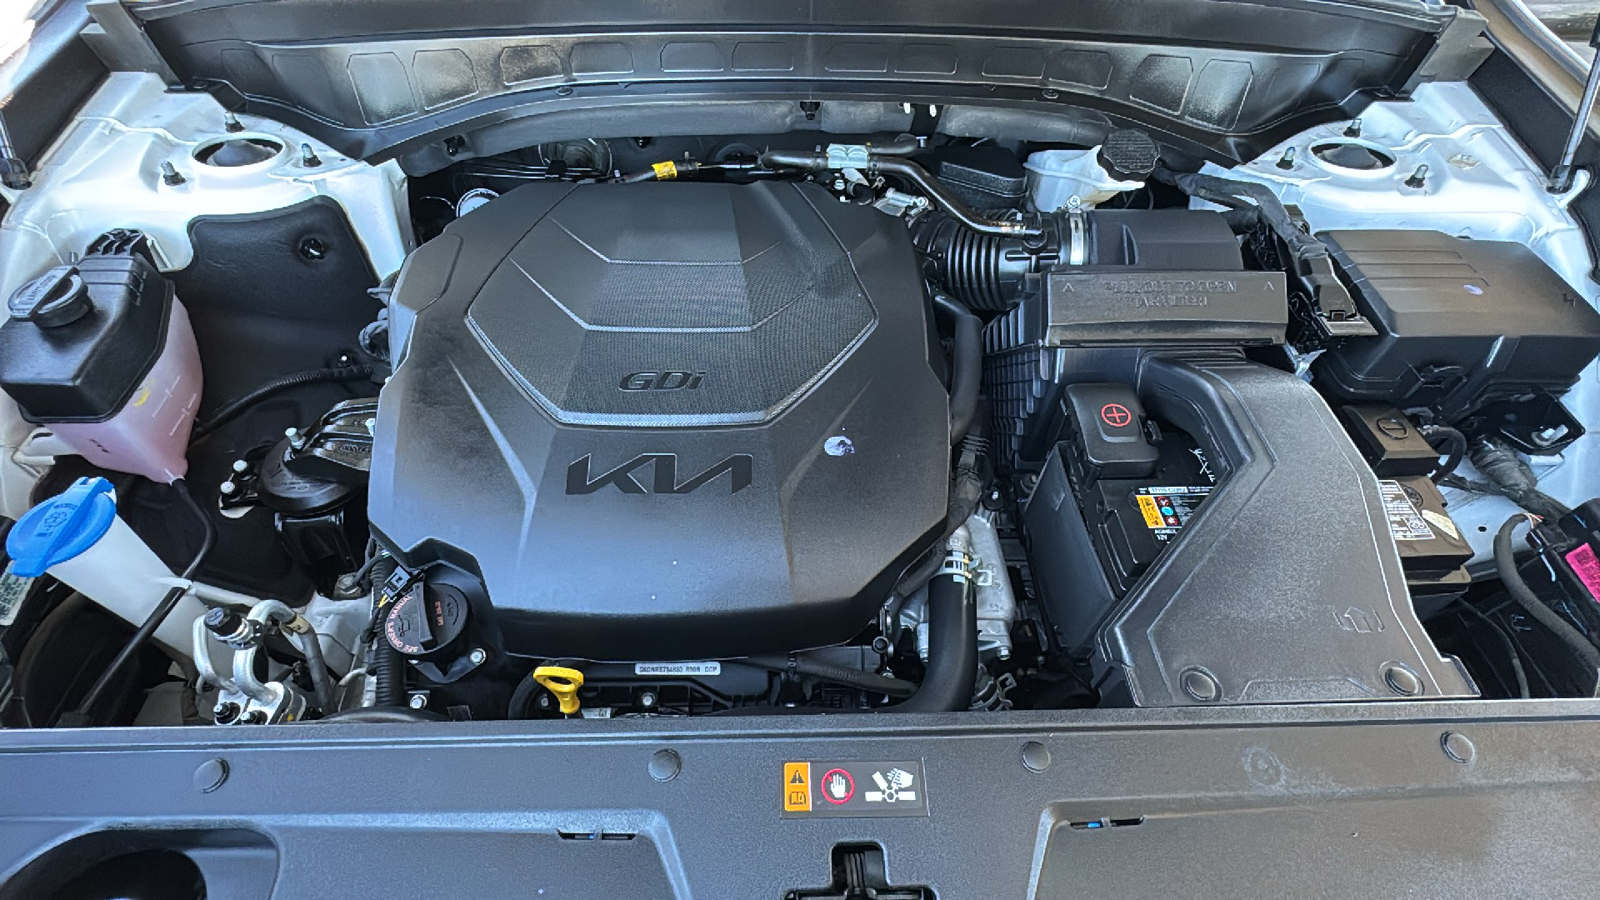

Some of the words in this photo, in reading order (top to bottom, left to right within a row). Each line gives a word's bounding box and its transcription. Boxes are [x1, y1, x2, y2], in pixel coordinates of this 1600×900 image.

[618, 371, 707, 391] GDi
[389, 595, 413, 619] MANUAL
[403, 644, 418, 653] SEE
